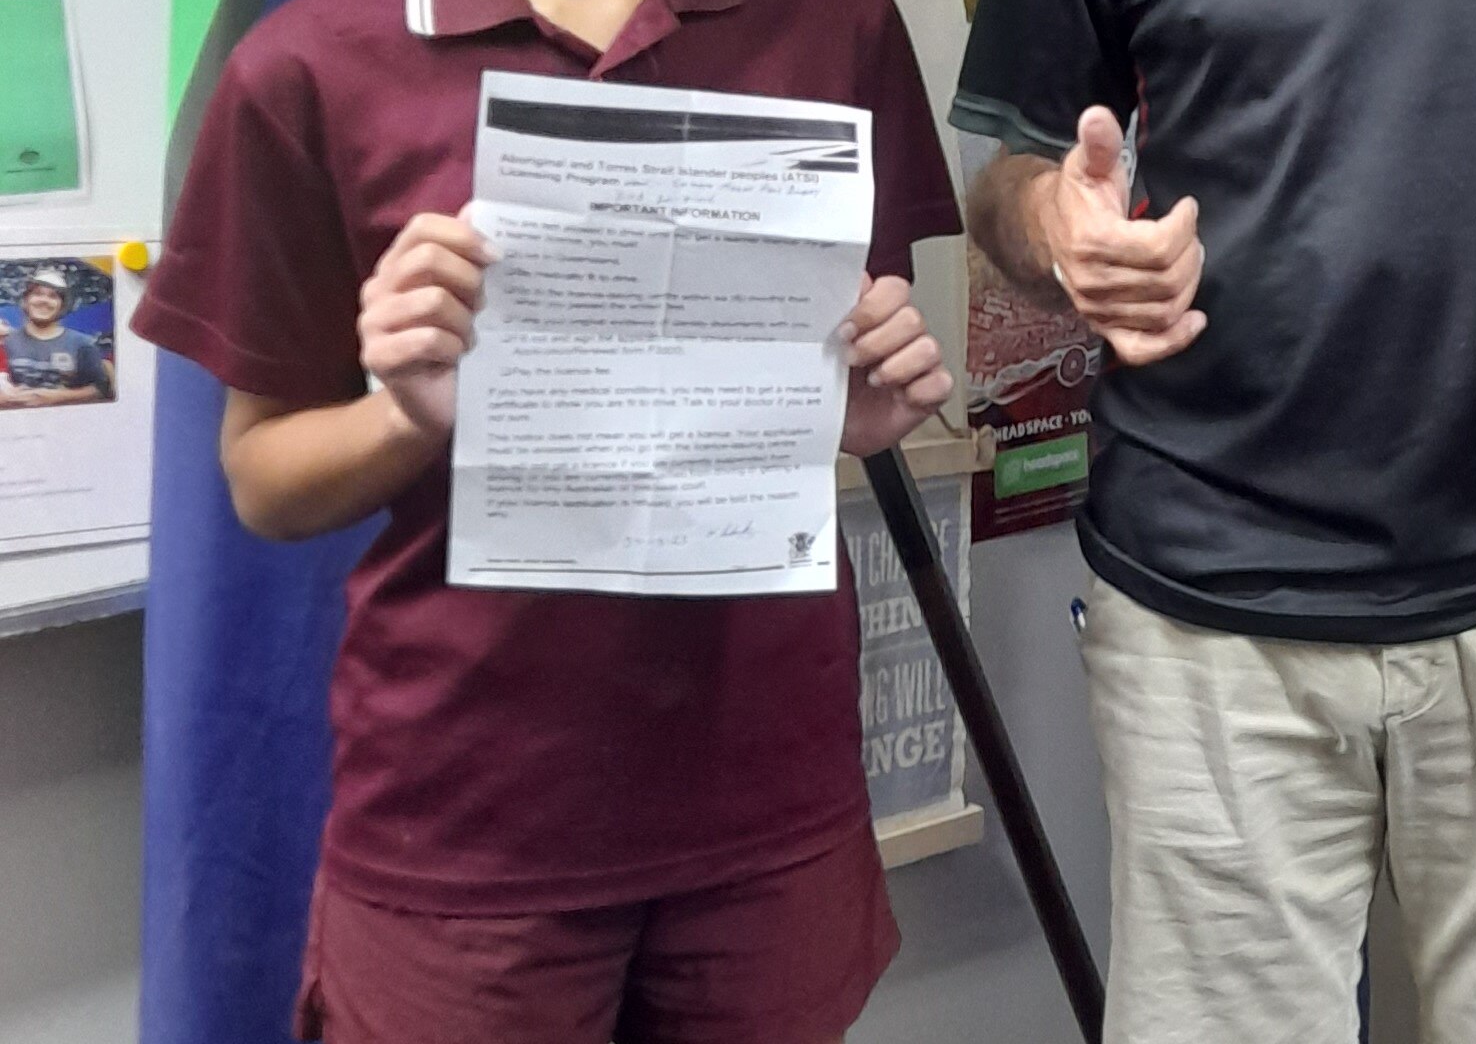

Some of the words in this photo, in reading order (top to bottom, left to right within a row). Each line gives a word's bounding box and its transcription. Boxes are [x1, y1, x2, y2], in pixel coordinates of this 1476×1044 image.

[671, 207, 761, 221] INFORMATION
[992, 415, 1063, 442] HEADSPACE
[895, 657, 947, 720] WILL
